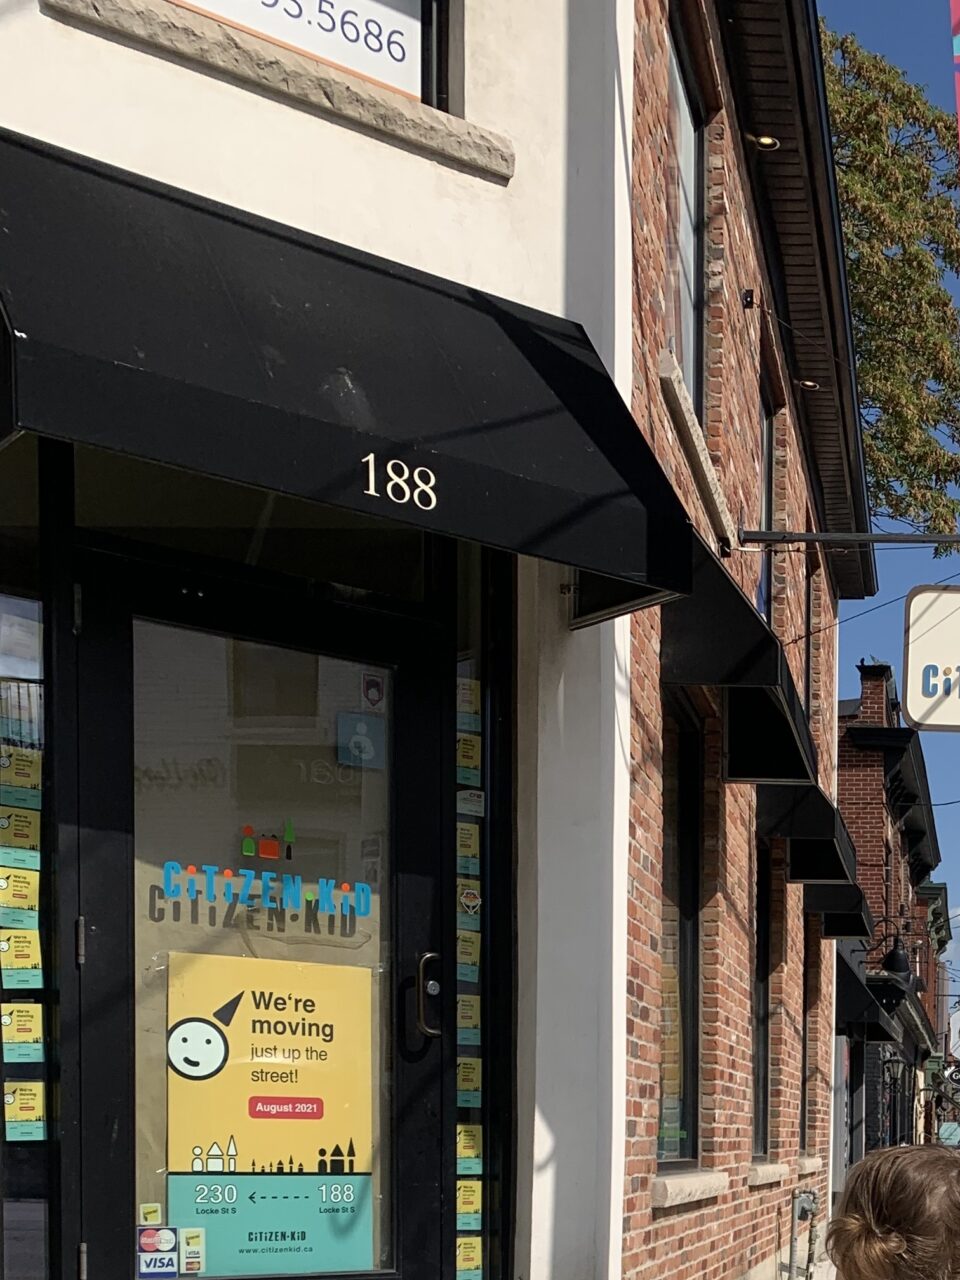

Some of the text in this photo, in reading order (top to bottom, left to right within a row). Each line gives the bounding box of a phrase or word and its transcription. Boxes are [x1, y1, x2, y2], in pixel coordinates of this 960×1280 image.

[360, 452, 438, 511] 188
[251, 990, 316, 1013] We're
[251, 1017, 334, 1043] moving
[250, 1043, 328, 1062] just up the
[251, 1069, 298, 1083] street!
[256, 1102, 317, 1114] August 2021
[195, 1184, 237, 1204] 230
[317, 1184, 354, 1203] 188
[195, 1207, 219, 1215] Locke
[221, 1207, 229, 1215] St
[238, 1246, 313, 1254] www.citizenkid.ca
[144, 1257, 175, 1269] VISA
